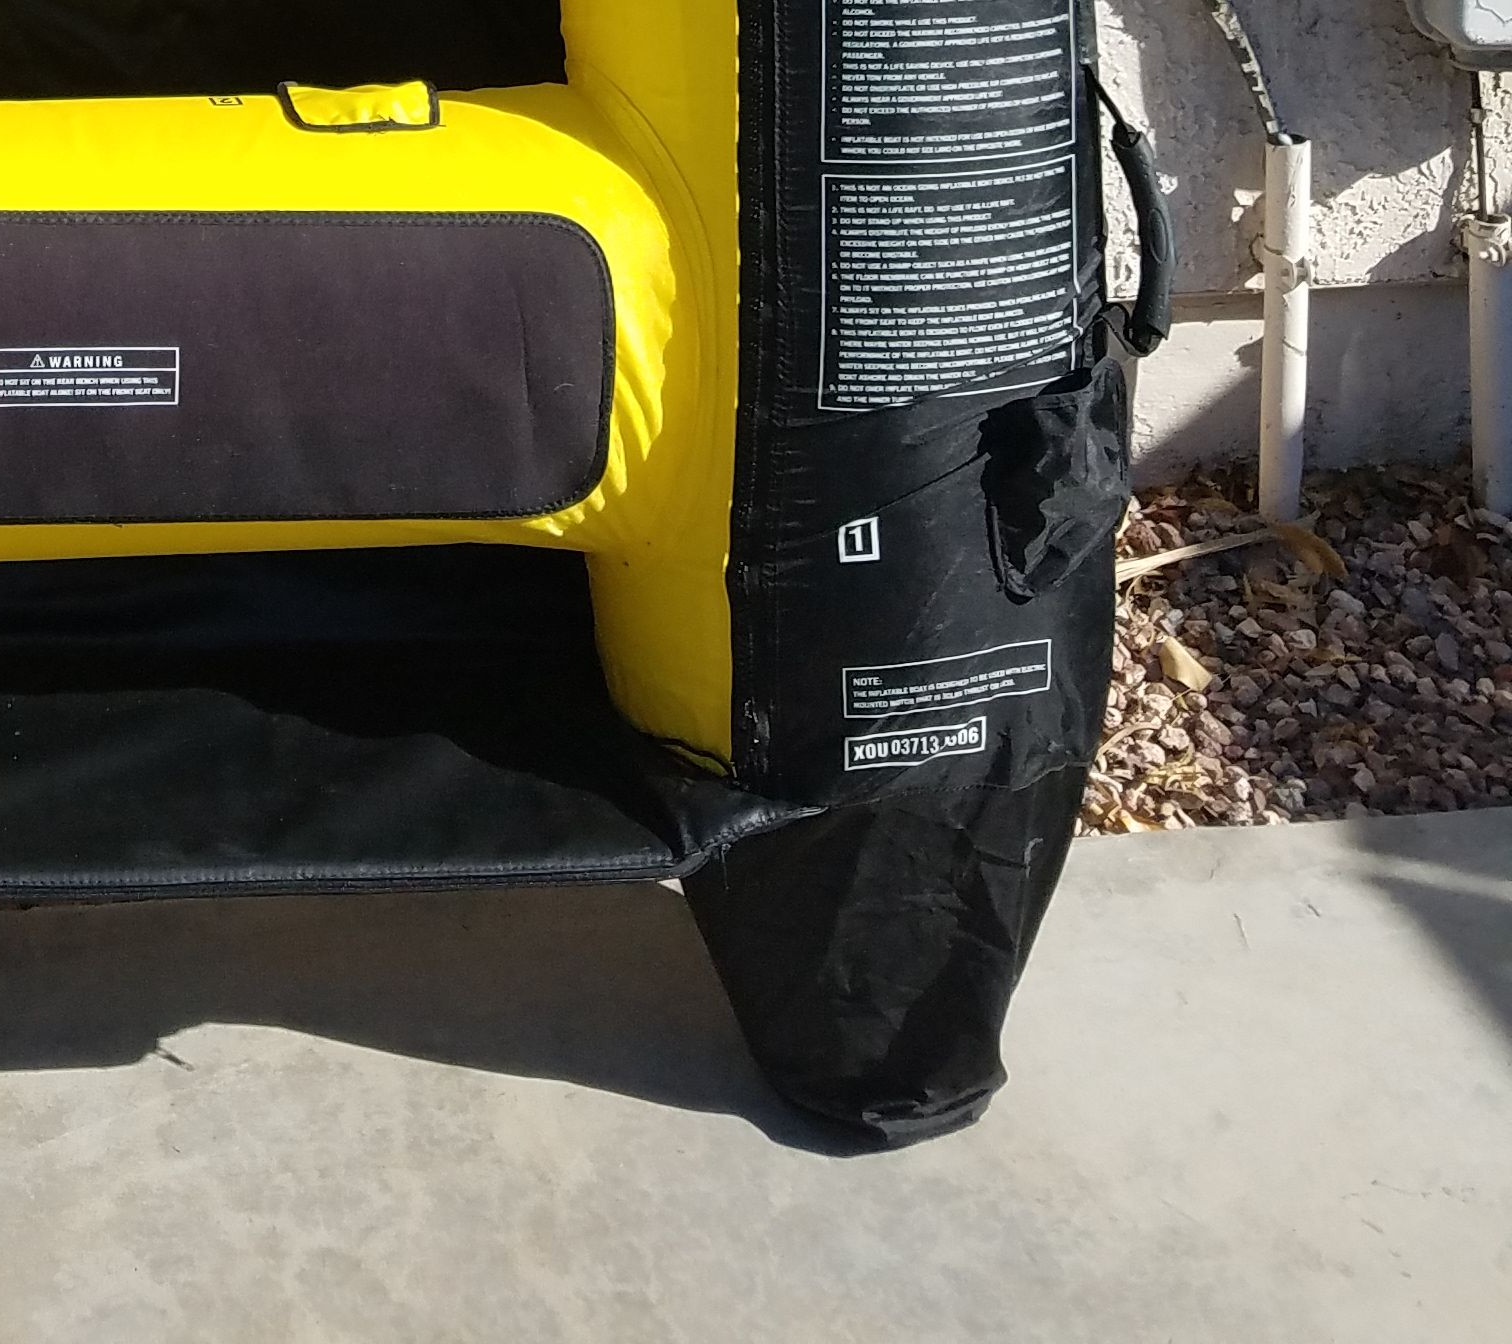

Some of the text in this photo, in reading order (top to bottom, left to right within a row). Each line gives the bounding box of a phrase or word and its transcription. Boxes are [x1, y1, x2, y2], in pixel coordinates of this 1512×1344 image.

[49, 356, 122, 367] WARNING
[848, 526, 864, 551] 1
[853, 675, 882, 688] NOTE:
[891, 734, 939, 758] 03713
